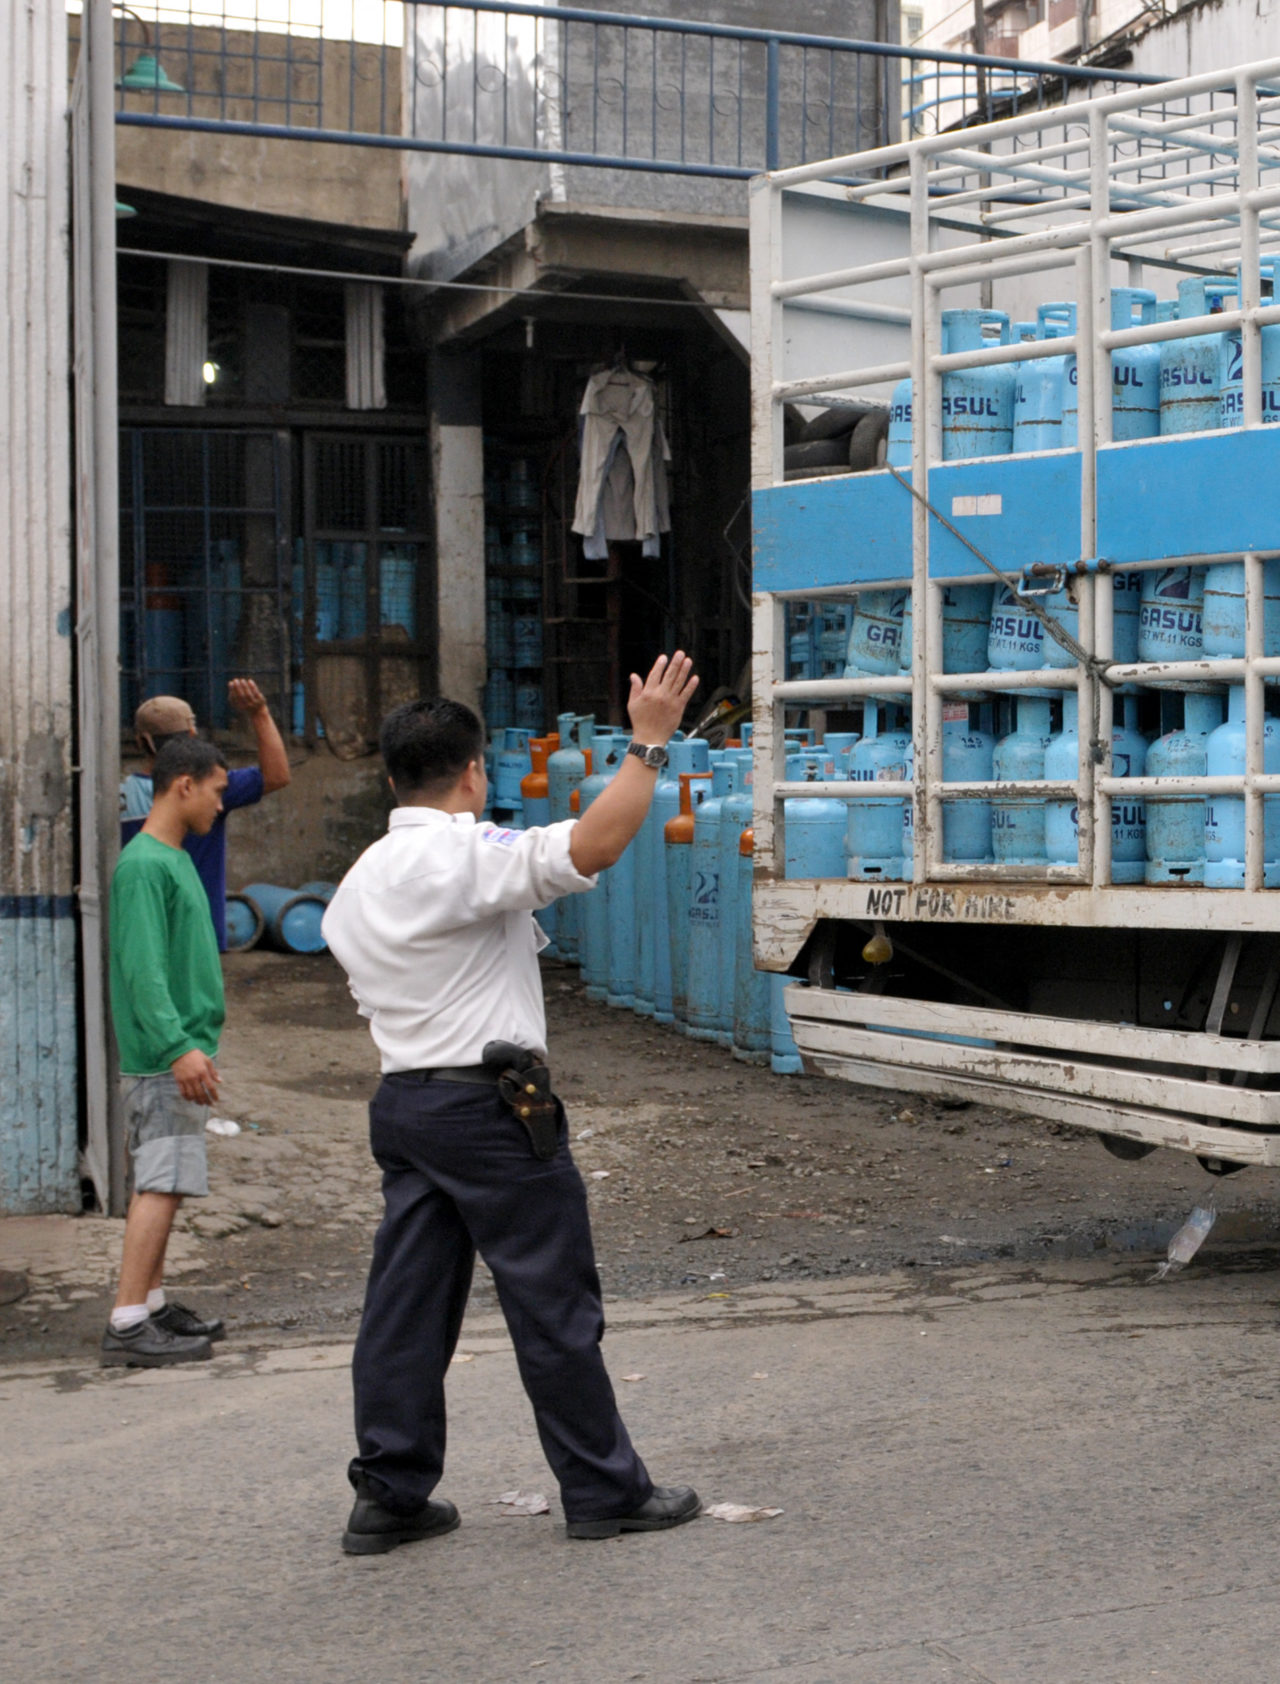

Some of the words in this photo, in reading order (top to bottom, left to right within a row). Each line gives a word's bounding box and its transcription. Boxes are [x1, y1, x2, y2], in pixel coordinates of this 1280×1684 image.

[1160, 364, 1212, 386] ASUL
[889, 402, 913, 424] GAS
[942, 396, 1000, 418] ASUL
[1019, 642, 1040, 654] KGS
[1180, 635, 1203, 647] KGS
[1111, 806, 1147, 826] SUL
[866, 888, 907, 916] NOT
[914, 888, 955, 918] FOR
